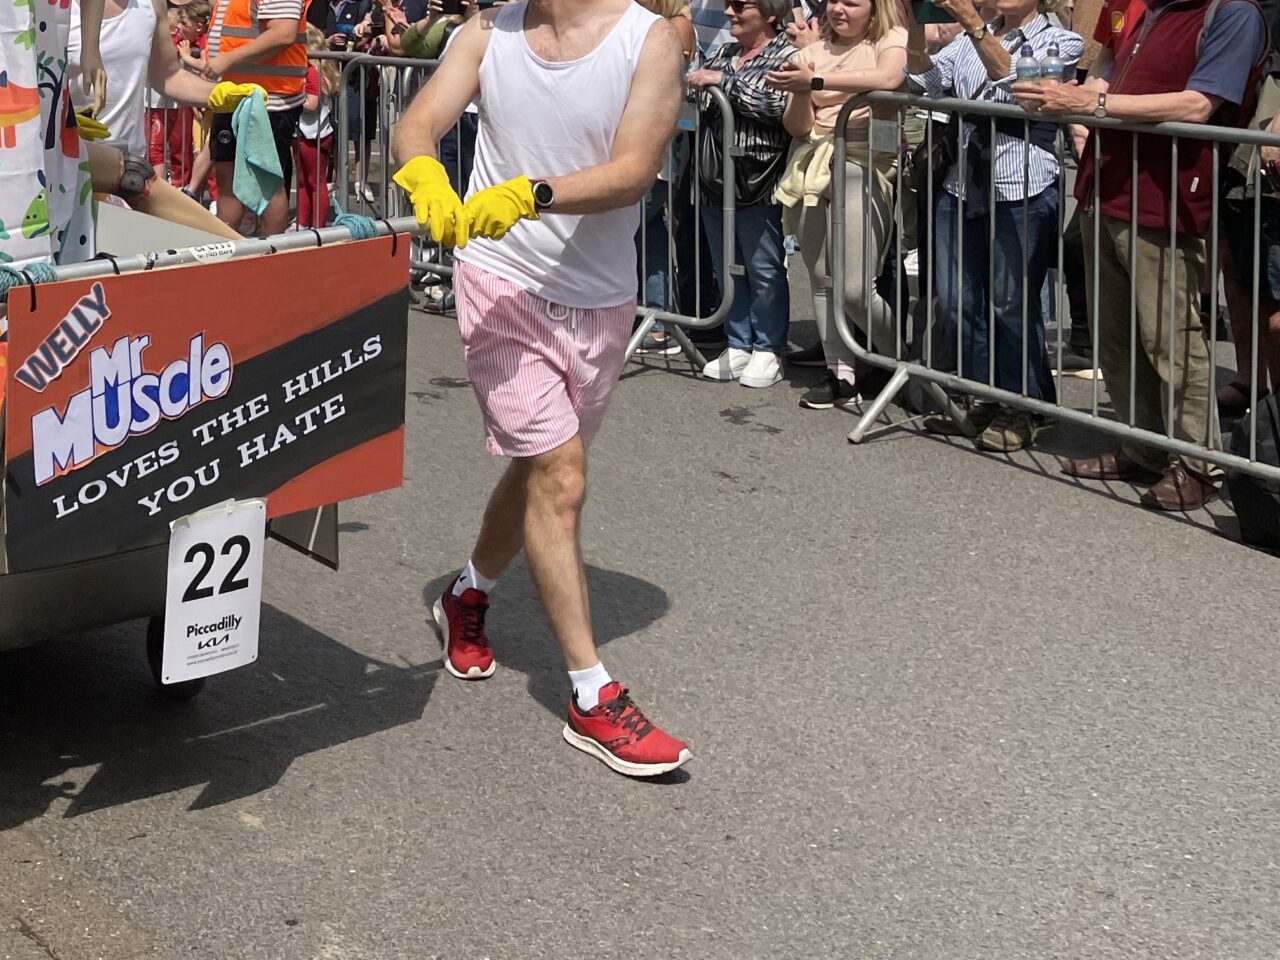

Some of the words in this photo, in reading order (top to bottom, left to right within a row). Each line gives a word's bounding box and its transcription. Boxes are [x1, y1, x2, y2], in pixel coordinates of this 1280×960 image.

[17, 282, 110, 391] WELLY
[89, 334, 150, 397] Mr
[52, 440, 180, 519] LOVES
[192, 394, 270, 446] THE
[281, 335, 383, 403] HILLS
[137, 458, 220, 517] YOU
[236, 393, 346, 468] HATE
[181, 534, 251, 603] 22
[186, 614, 242, 637] Piccadilly
